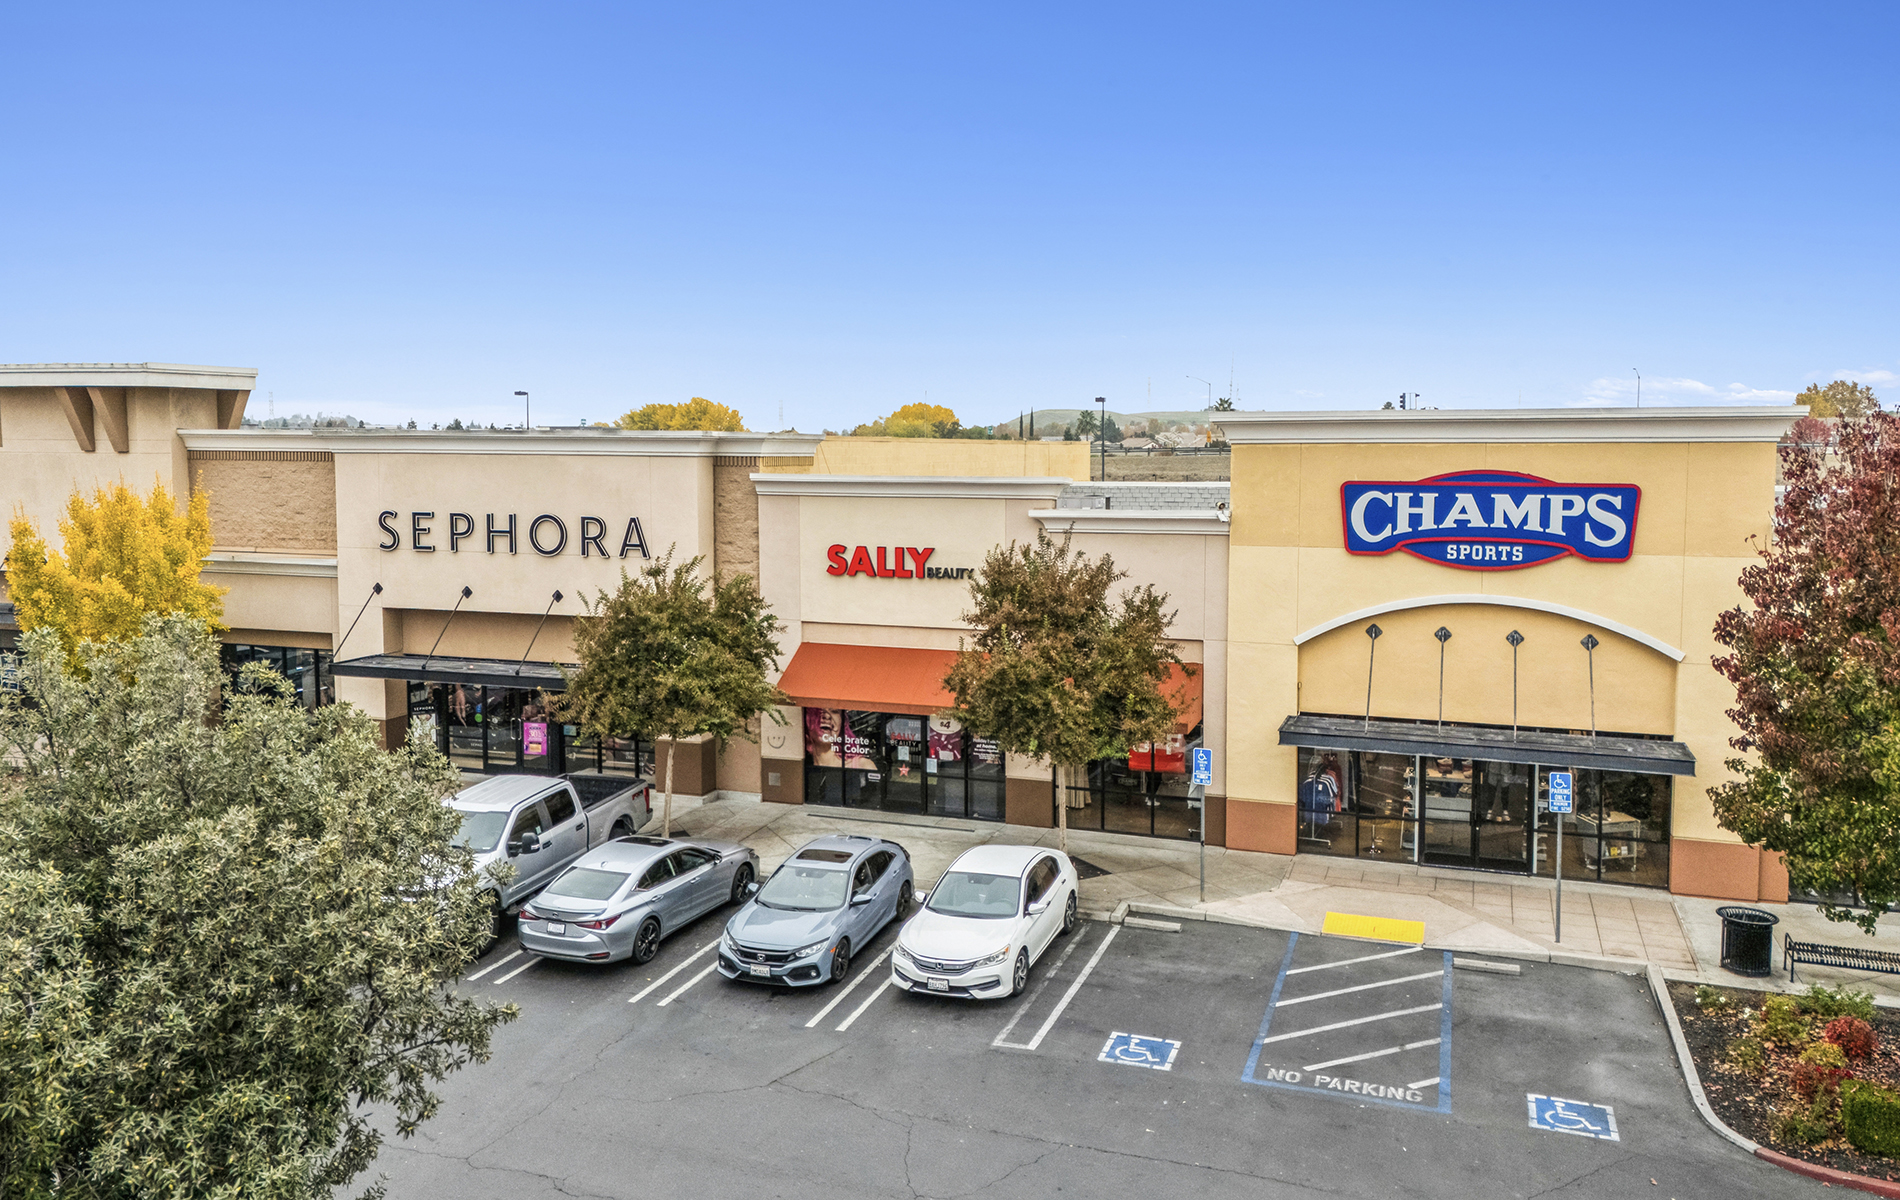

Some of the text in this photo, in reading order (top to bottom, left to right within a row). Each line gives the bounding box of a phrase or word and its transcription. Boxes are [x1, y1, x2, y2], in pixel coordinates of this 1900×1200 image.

[377, 509, 651, 560] SEPHORA
[1350, 490, 1628, 548] CHAMPS
[826, 543, 975, 580] SALLY BEAUTY
[1446, 544, 1524, 562] SPORTS
[940, 721, 951, 729] $4
[830, 743, 870, 754] in Color
[1266, 1068, 1424, 1103] NO PARKING
